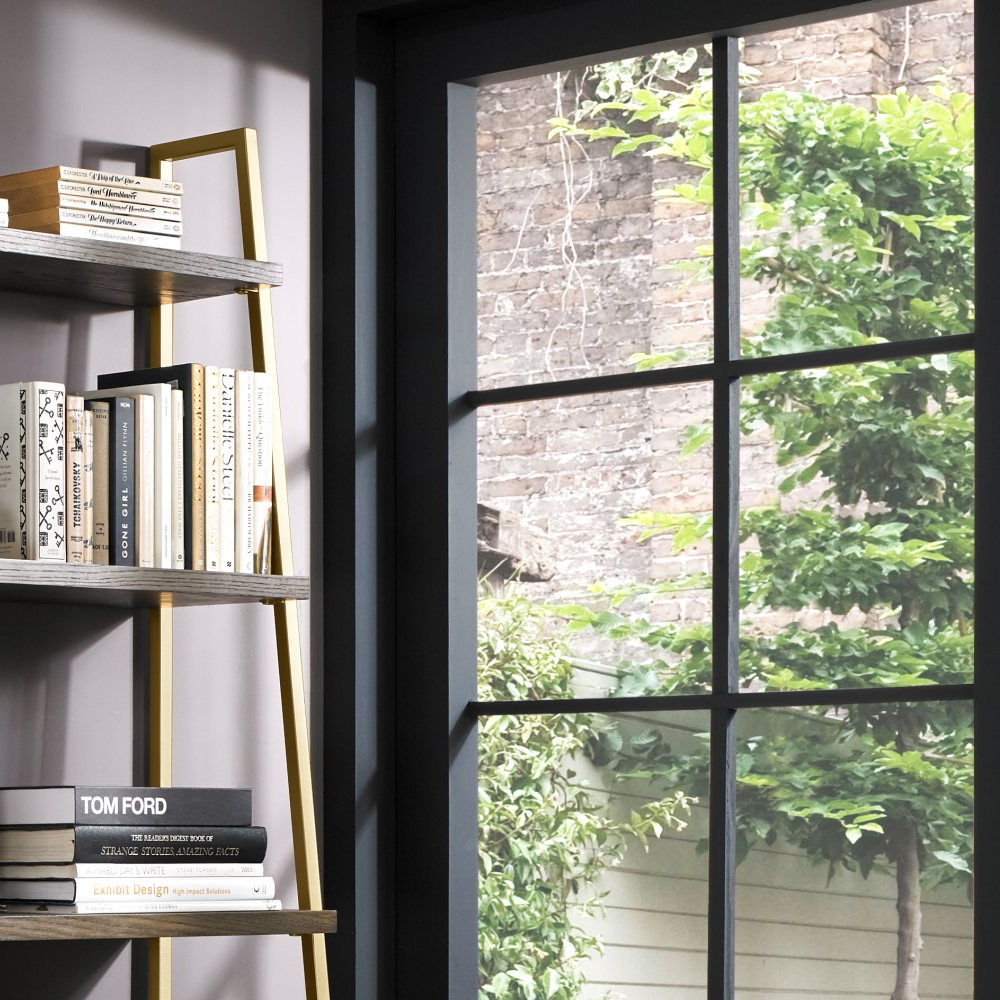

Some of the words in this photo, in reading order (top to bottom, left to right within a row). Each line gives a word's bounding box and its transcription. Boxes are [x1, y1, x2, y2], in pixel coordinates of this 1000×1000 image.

[108, 174, 114, 182] of
[87, 186, 102, 196] Lord
[102, 187, 138, 200] Hornblower
[87, 213, 98, 221] The
[98, 214, 116, 225] Happy
[116, 217, 133, 227] Return
[221, 373, 235, 446] Danielle
[256, 432, 264, 467] Question
[221, 453, 235, 501] Steel
[72, 462, 82, 528] TCHAIKOVSKY
[121, 487, 129, 517] GIRL
[121, 524, 129, 559] GONE
[80, 796, 118, 815] TOM
[122, 797, 167, 815] FORD
[131, 834, 143, 842] THE
[170, 834, 189, 842] DIGEST
[100, 846, 139, 856] STRANGE
[141, 846, 175, 857] STORIES,
[175, 847, 214, 856] AMAZING
[215, 847, 240, 856] FACTS
[143, 865, 166, 875] WRITE
[93, 883, 130, 896] Exhibit
[133, 883, 169, 897] Design
[172, 888, 184, 896] High
[186, 888, 205, 896] Impact
